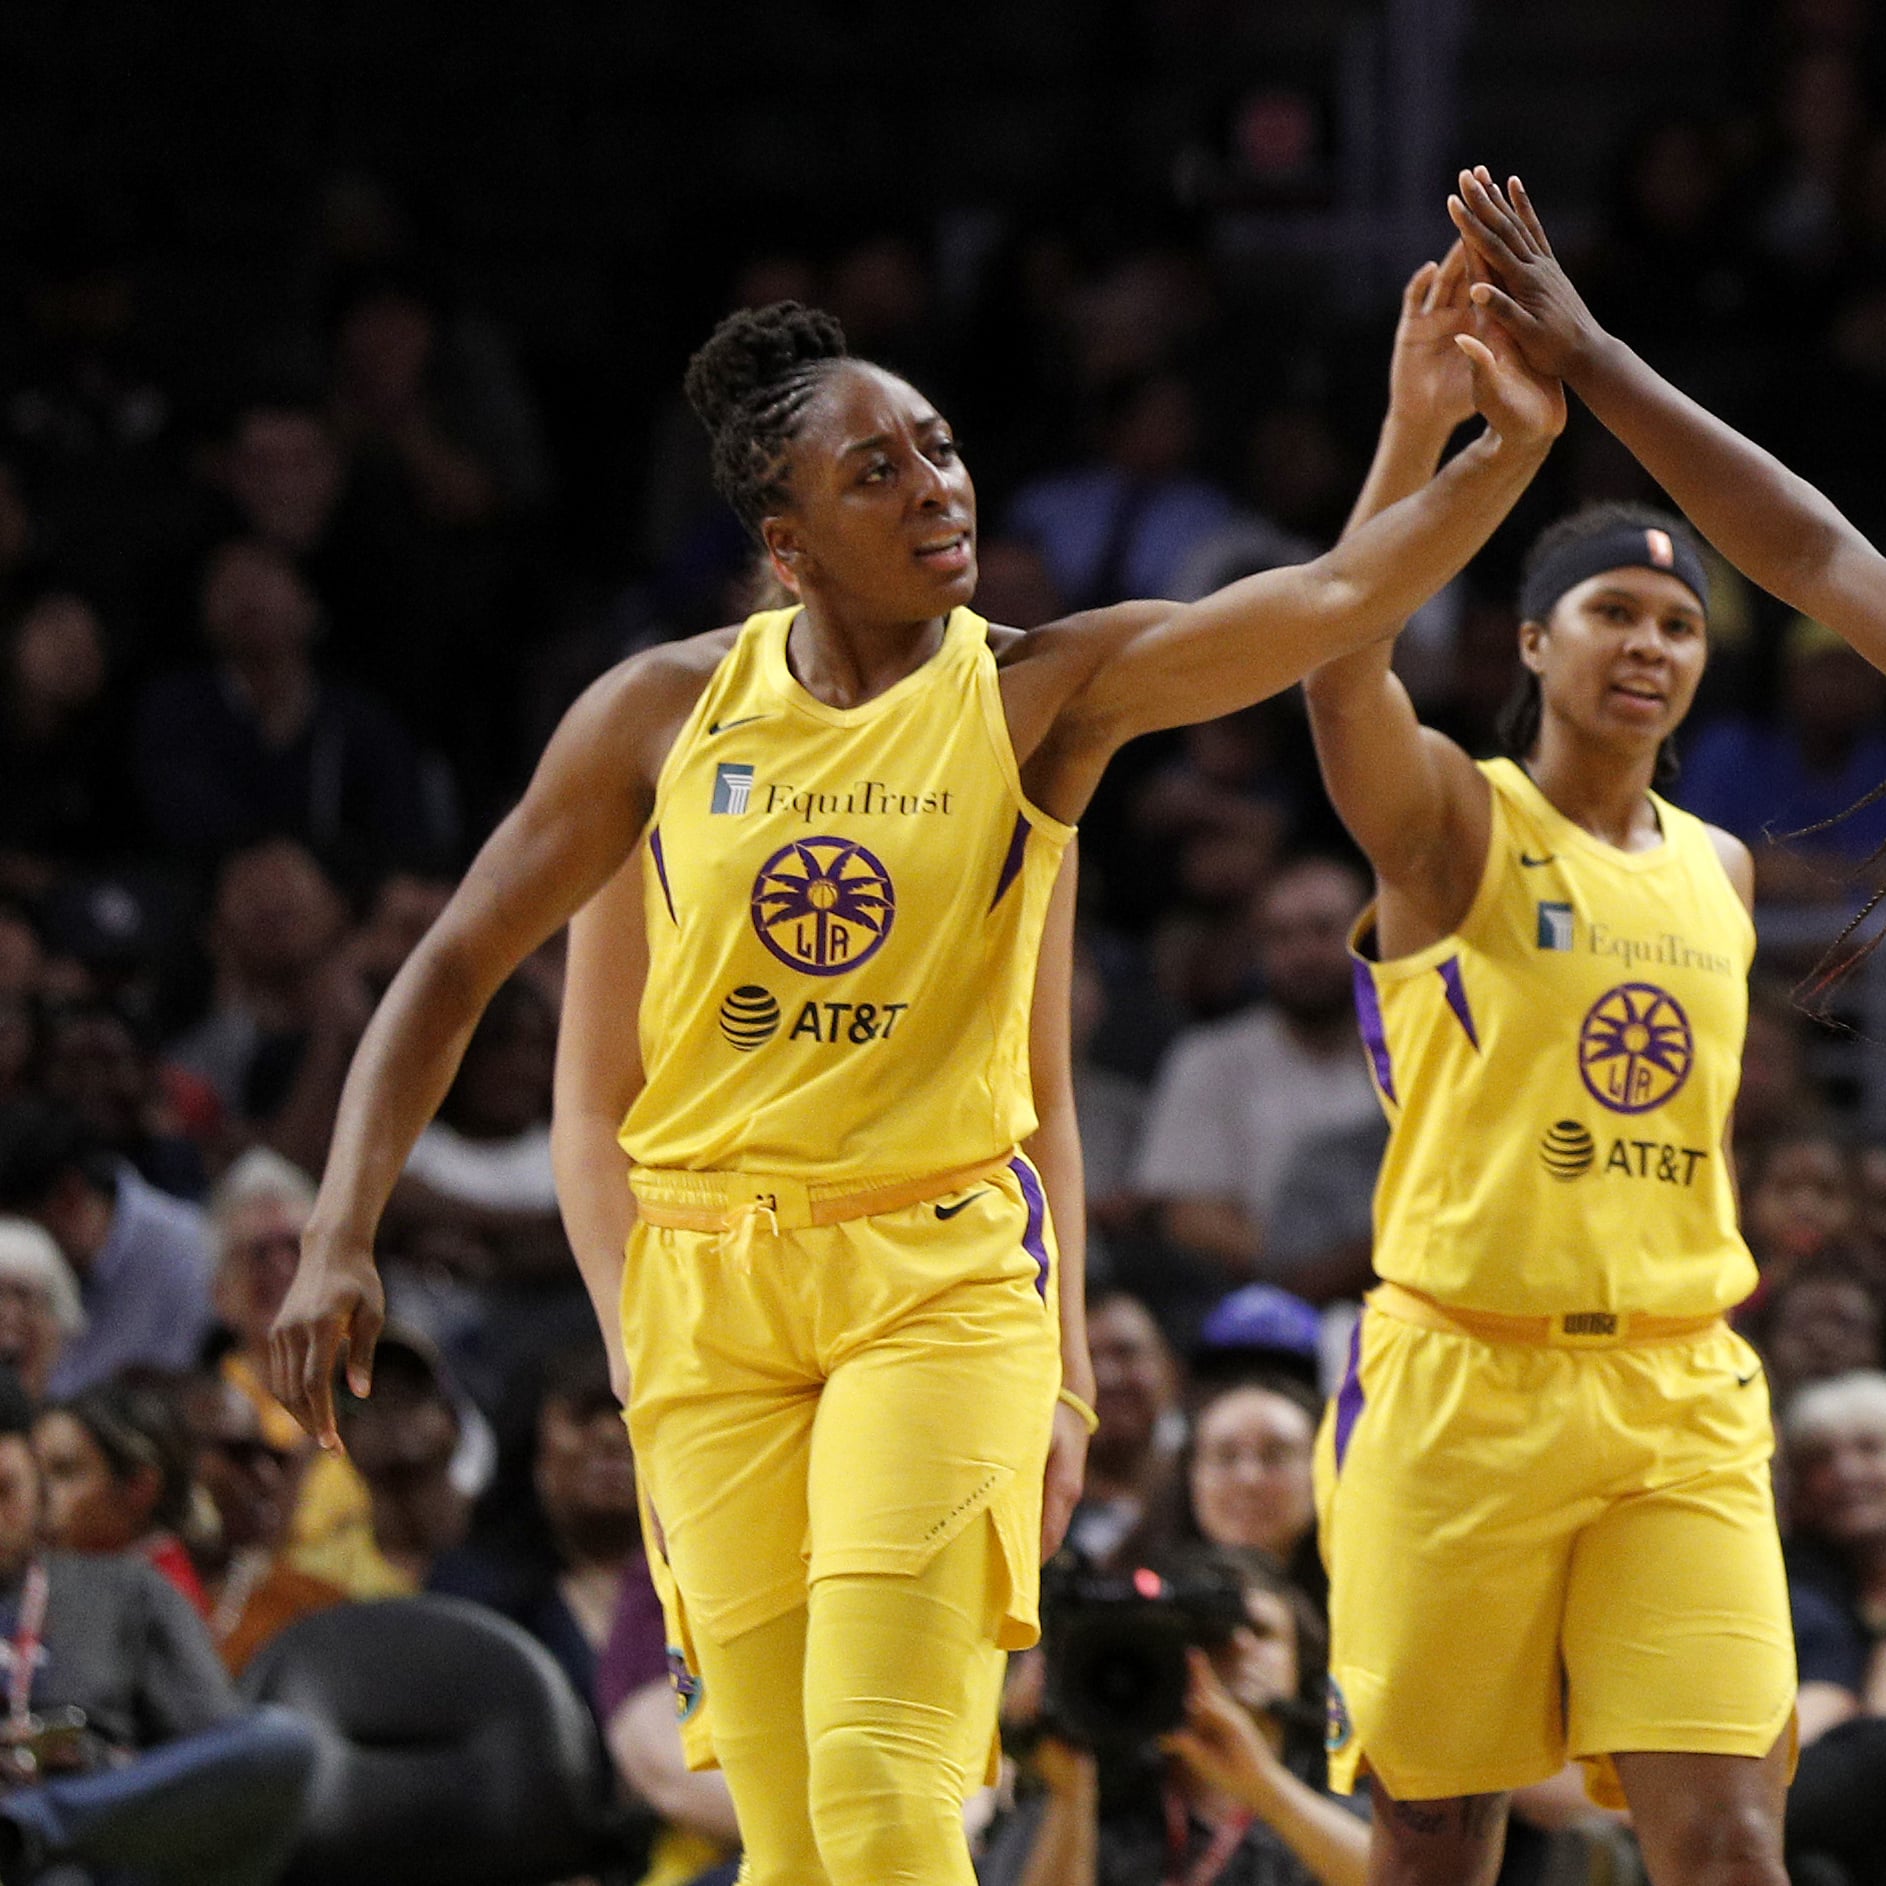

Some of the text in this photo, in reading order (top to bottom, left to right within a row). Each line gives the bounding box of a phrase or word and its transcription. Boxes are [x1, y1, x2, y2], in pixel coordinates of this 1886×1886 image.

[766, 781, 954, 823] EquiTrust
[1588, 922, 1733, 978] EquiTrust
[789, 1002, 909, 1044] AT&T
[1604, 1139, 1708, 1187] AT&T
